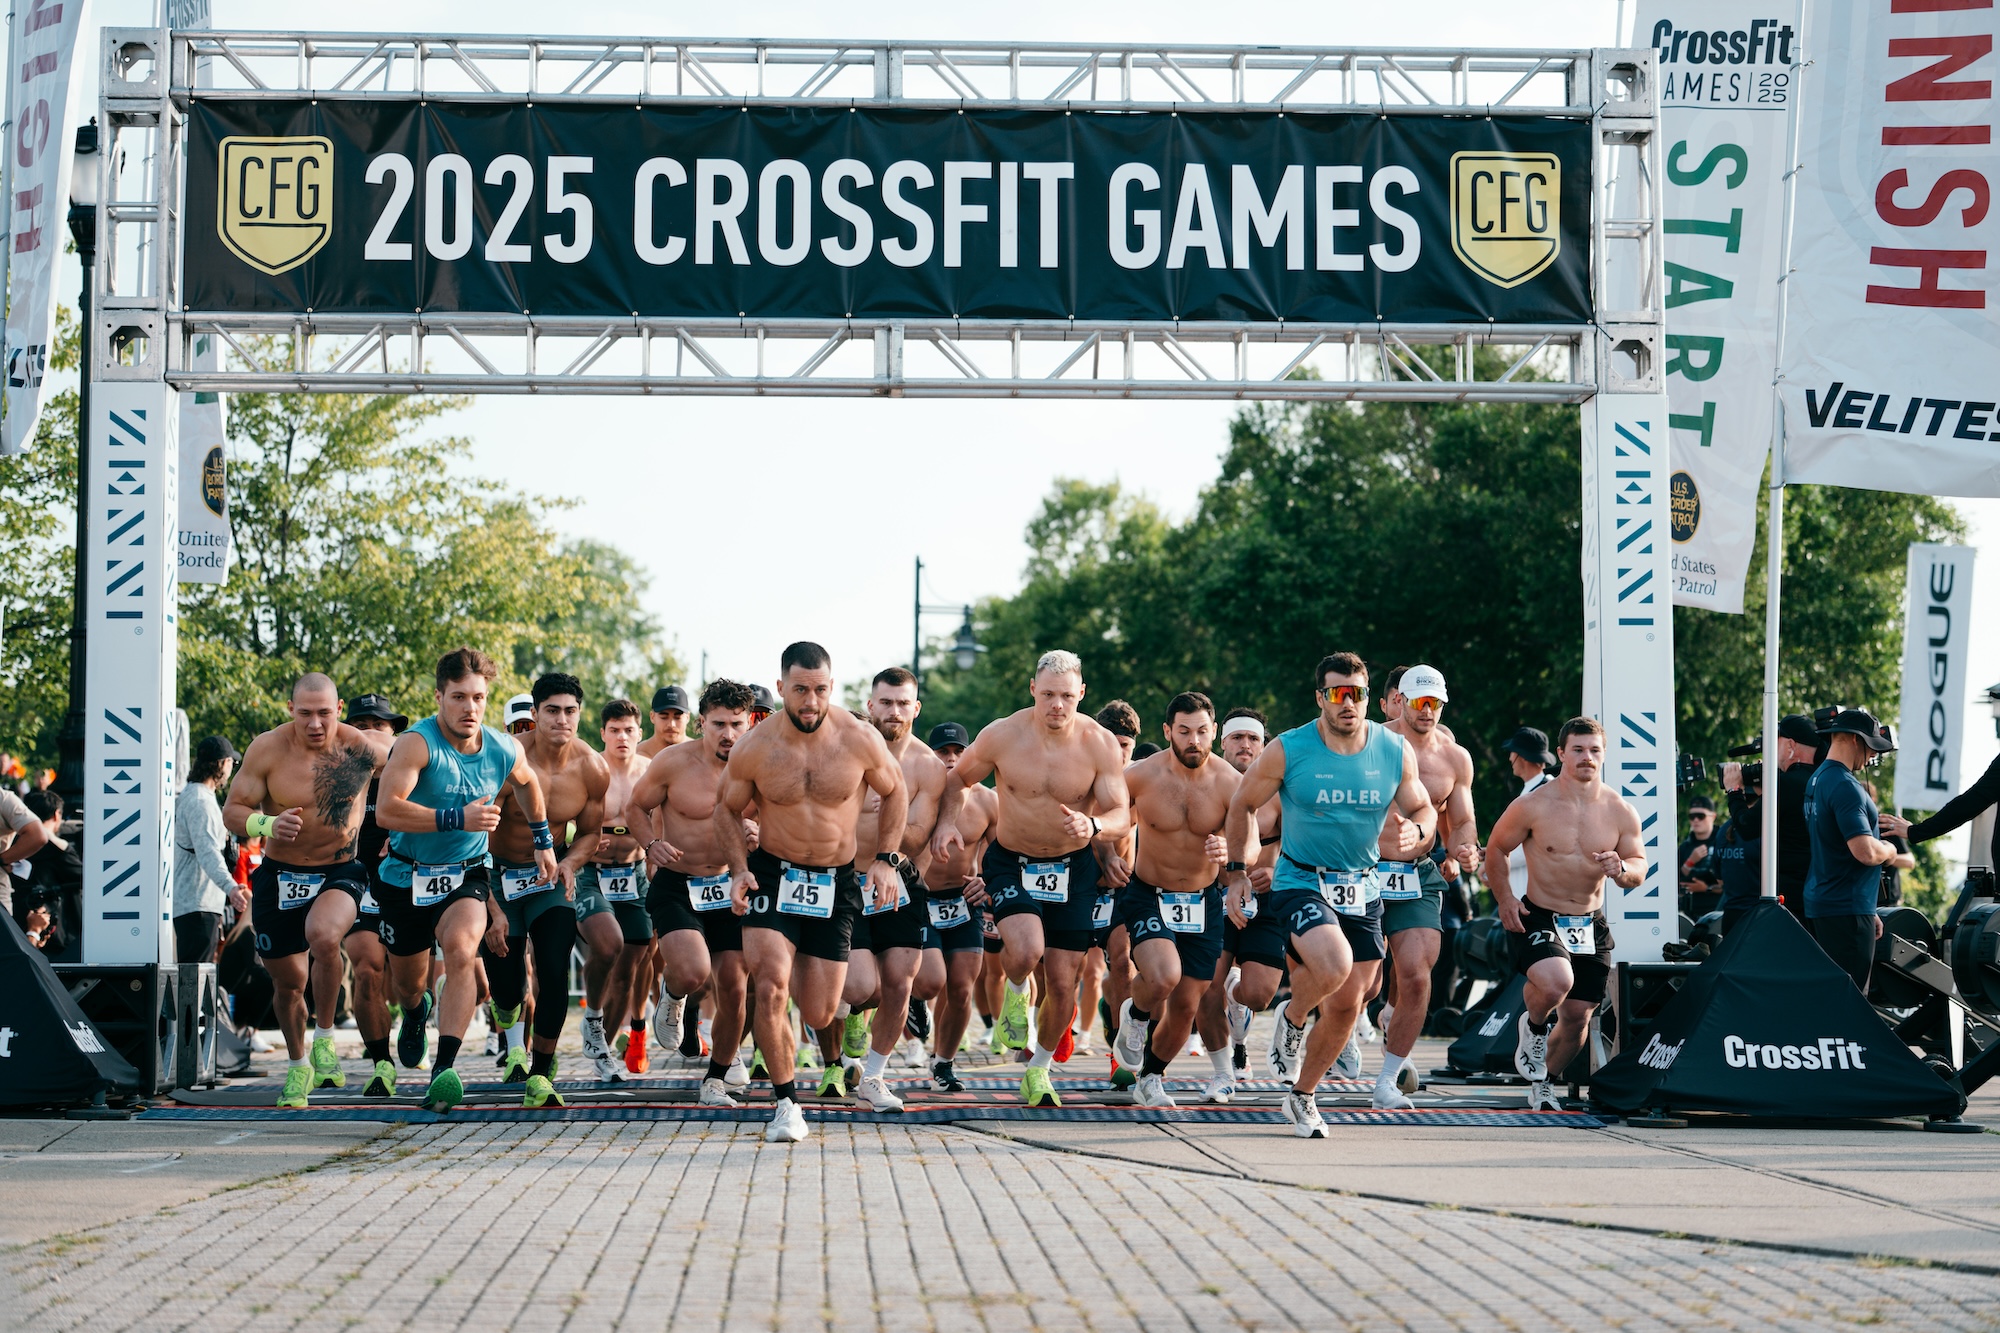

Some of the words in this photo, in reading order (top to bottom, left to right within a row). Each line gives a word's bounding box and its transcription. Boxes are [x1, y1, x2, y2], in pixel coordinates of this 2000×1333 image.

[1652, 19, 1794, 65] CrossFit
[1663, 72, 1741, 103] AMES
[1760, 73, 1789, 87] 20
[1757, 89, 1787, 103] 25
[238, 156, 321, 220] CFG
[1471, 170, 1548, 234] CFG
[364, 152, 594, 264] 2025
[634, 156, 1075, 269] CROSSFIT
[1108, 162, 1422, 273] GAMES
[1664, 139, 1749, 447] START
[1673, 481, 1689, 495] U.S.
[1670, 499, 1697, 512] ORDER
[1680, 555, 1717, 576] States
[1678, 576, 1717, 597] Patrol
[1925, 562, 1956, 792] ROGUE
[1315, 788, 1382, 804] ADLER
[287, 882, 311, 899] 35
[426, 876, 452, 895] 48
[515, 874, 539, 891] 34
[609, 878, 629, 893] 42
[1035, 873, 1058, 891] 43
[1386, 873, 1405, 891] 41
[701, 885, 725, 902] 46
[791, 883, 819, 905] 45
[1333, 885, 1356, 906] 39
[575, 896, 596, 919] 37
[938, 904, 959, 920] 52
[1172, 904, 1191, 922] 31
[1291, 902, 1323, 931] 23
[1133, 916, 1162, 939] 26
[1527, 929, 1556, 946] 27
[1567, 927, 1586, 945] 32
[1723, 1034, 1868, 1071] CrossFit
